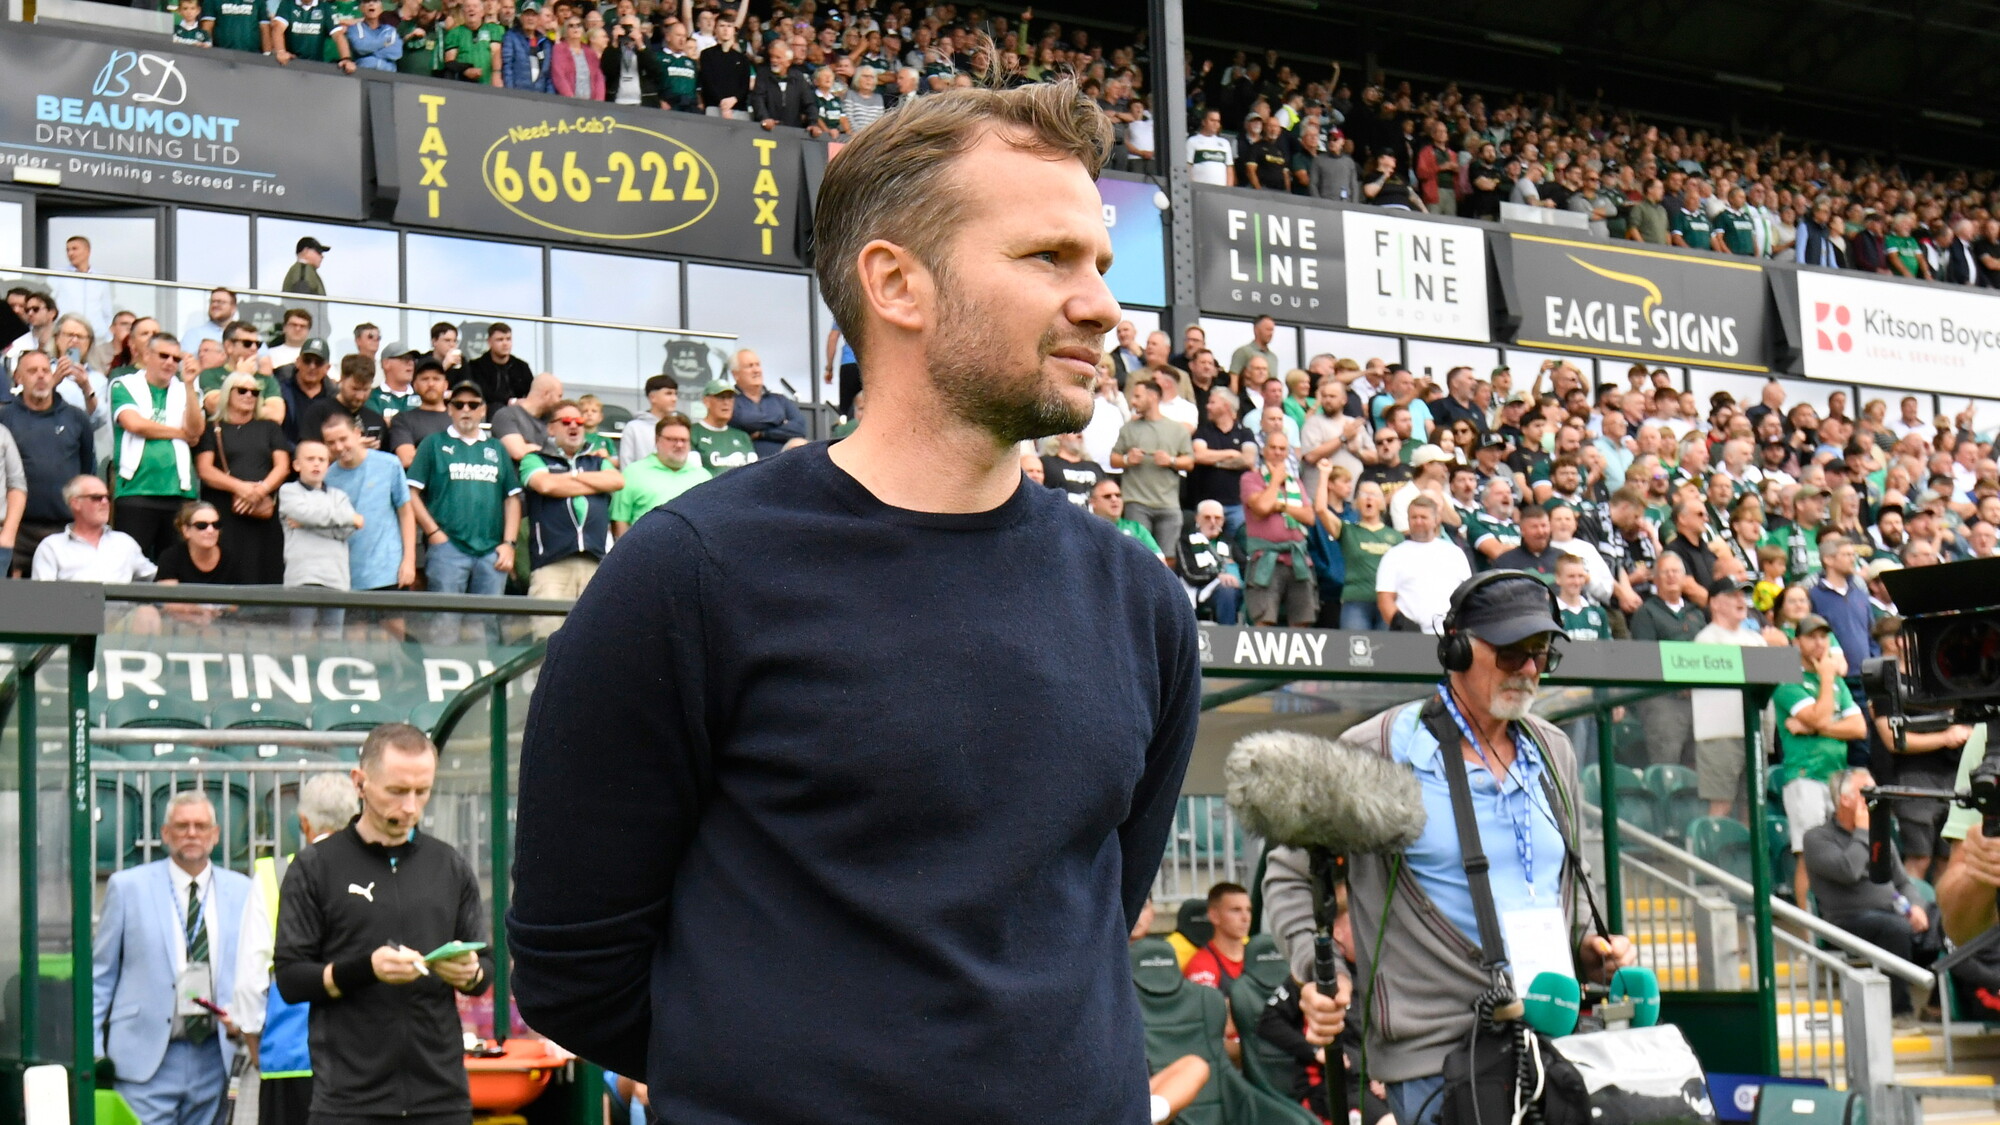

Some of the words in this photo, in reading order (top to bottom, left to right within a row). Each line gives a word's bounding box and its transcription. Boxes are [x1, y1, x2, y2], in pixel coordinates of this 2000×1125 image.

[36, 94, 240, 143] BEAUMONT
[508, 116, 616, 144] Need-A-Cab?
[35, 123, 183, 159] DRYLINING
[193, 148, 240, 165] LTD
[418, 94, 449, 219] TAXI
[0, 152, 49, 169] nder
[68, 157, 152, 184] Drylining
[172, 170, 233, 190] Screed
[252, 179, 286, 196] Fire
[493, 150, 708, 203] 666-222
[752, 138, 780, 256] TAXI
[1231, 289, 1320, 309] GROUP
[1545, 296, 1642, 346] EAGLE
[1652, 310, 1739, 357] SIGNS
[1864, 308, 1934, 340] Kitson
[1233, 631, 1328, 666] AWAY
[1670, 655, 1700, 669] Uber
[1703, 655, 1734, 670] Eats
